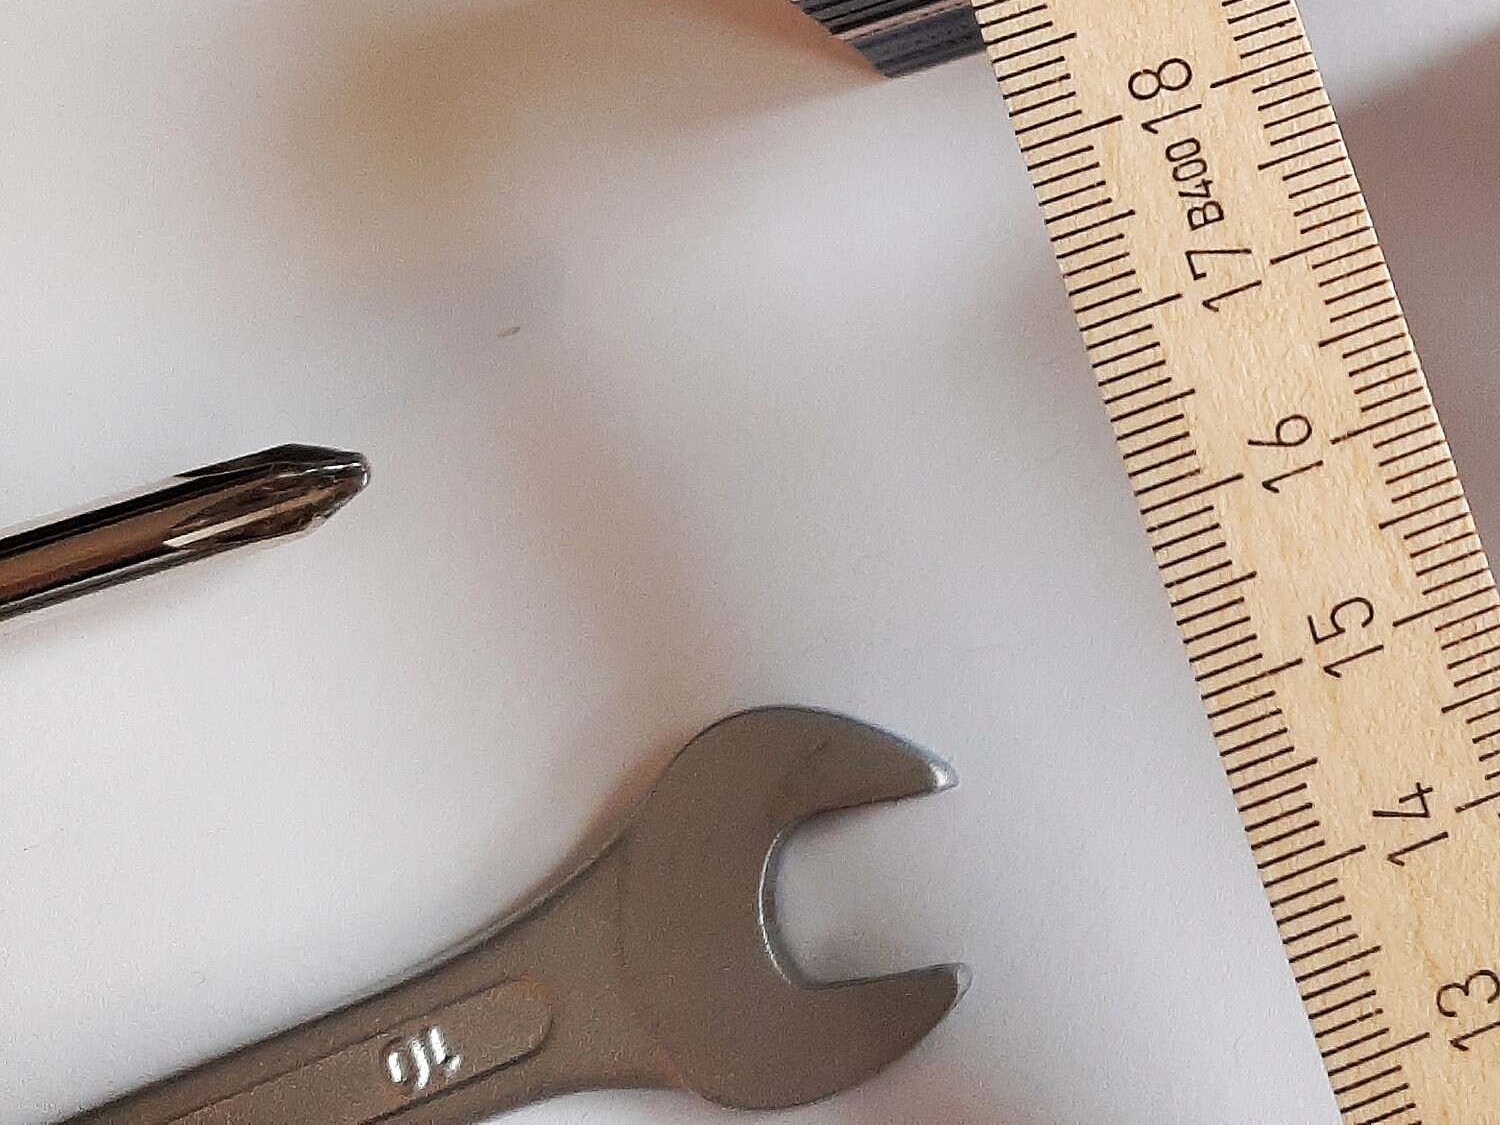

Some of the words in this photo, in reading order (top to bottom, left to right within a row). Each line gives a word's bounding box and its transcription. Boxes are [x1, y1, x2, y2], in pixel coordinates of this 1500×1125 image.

[1128, 57, 1202, 134] 18
[1165, 137, 1224, 230] B400
[1185, 249, 1262, 313] 17
[1248, 414, 1324, 494] 16
[1307, 596, 1384, 679] 15
[1372, 781, 1448, 867] 14
